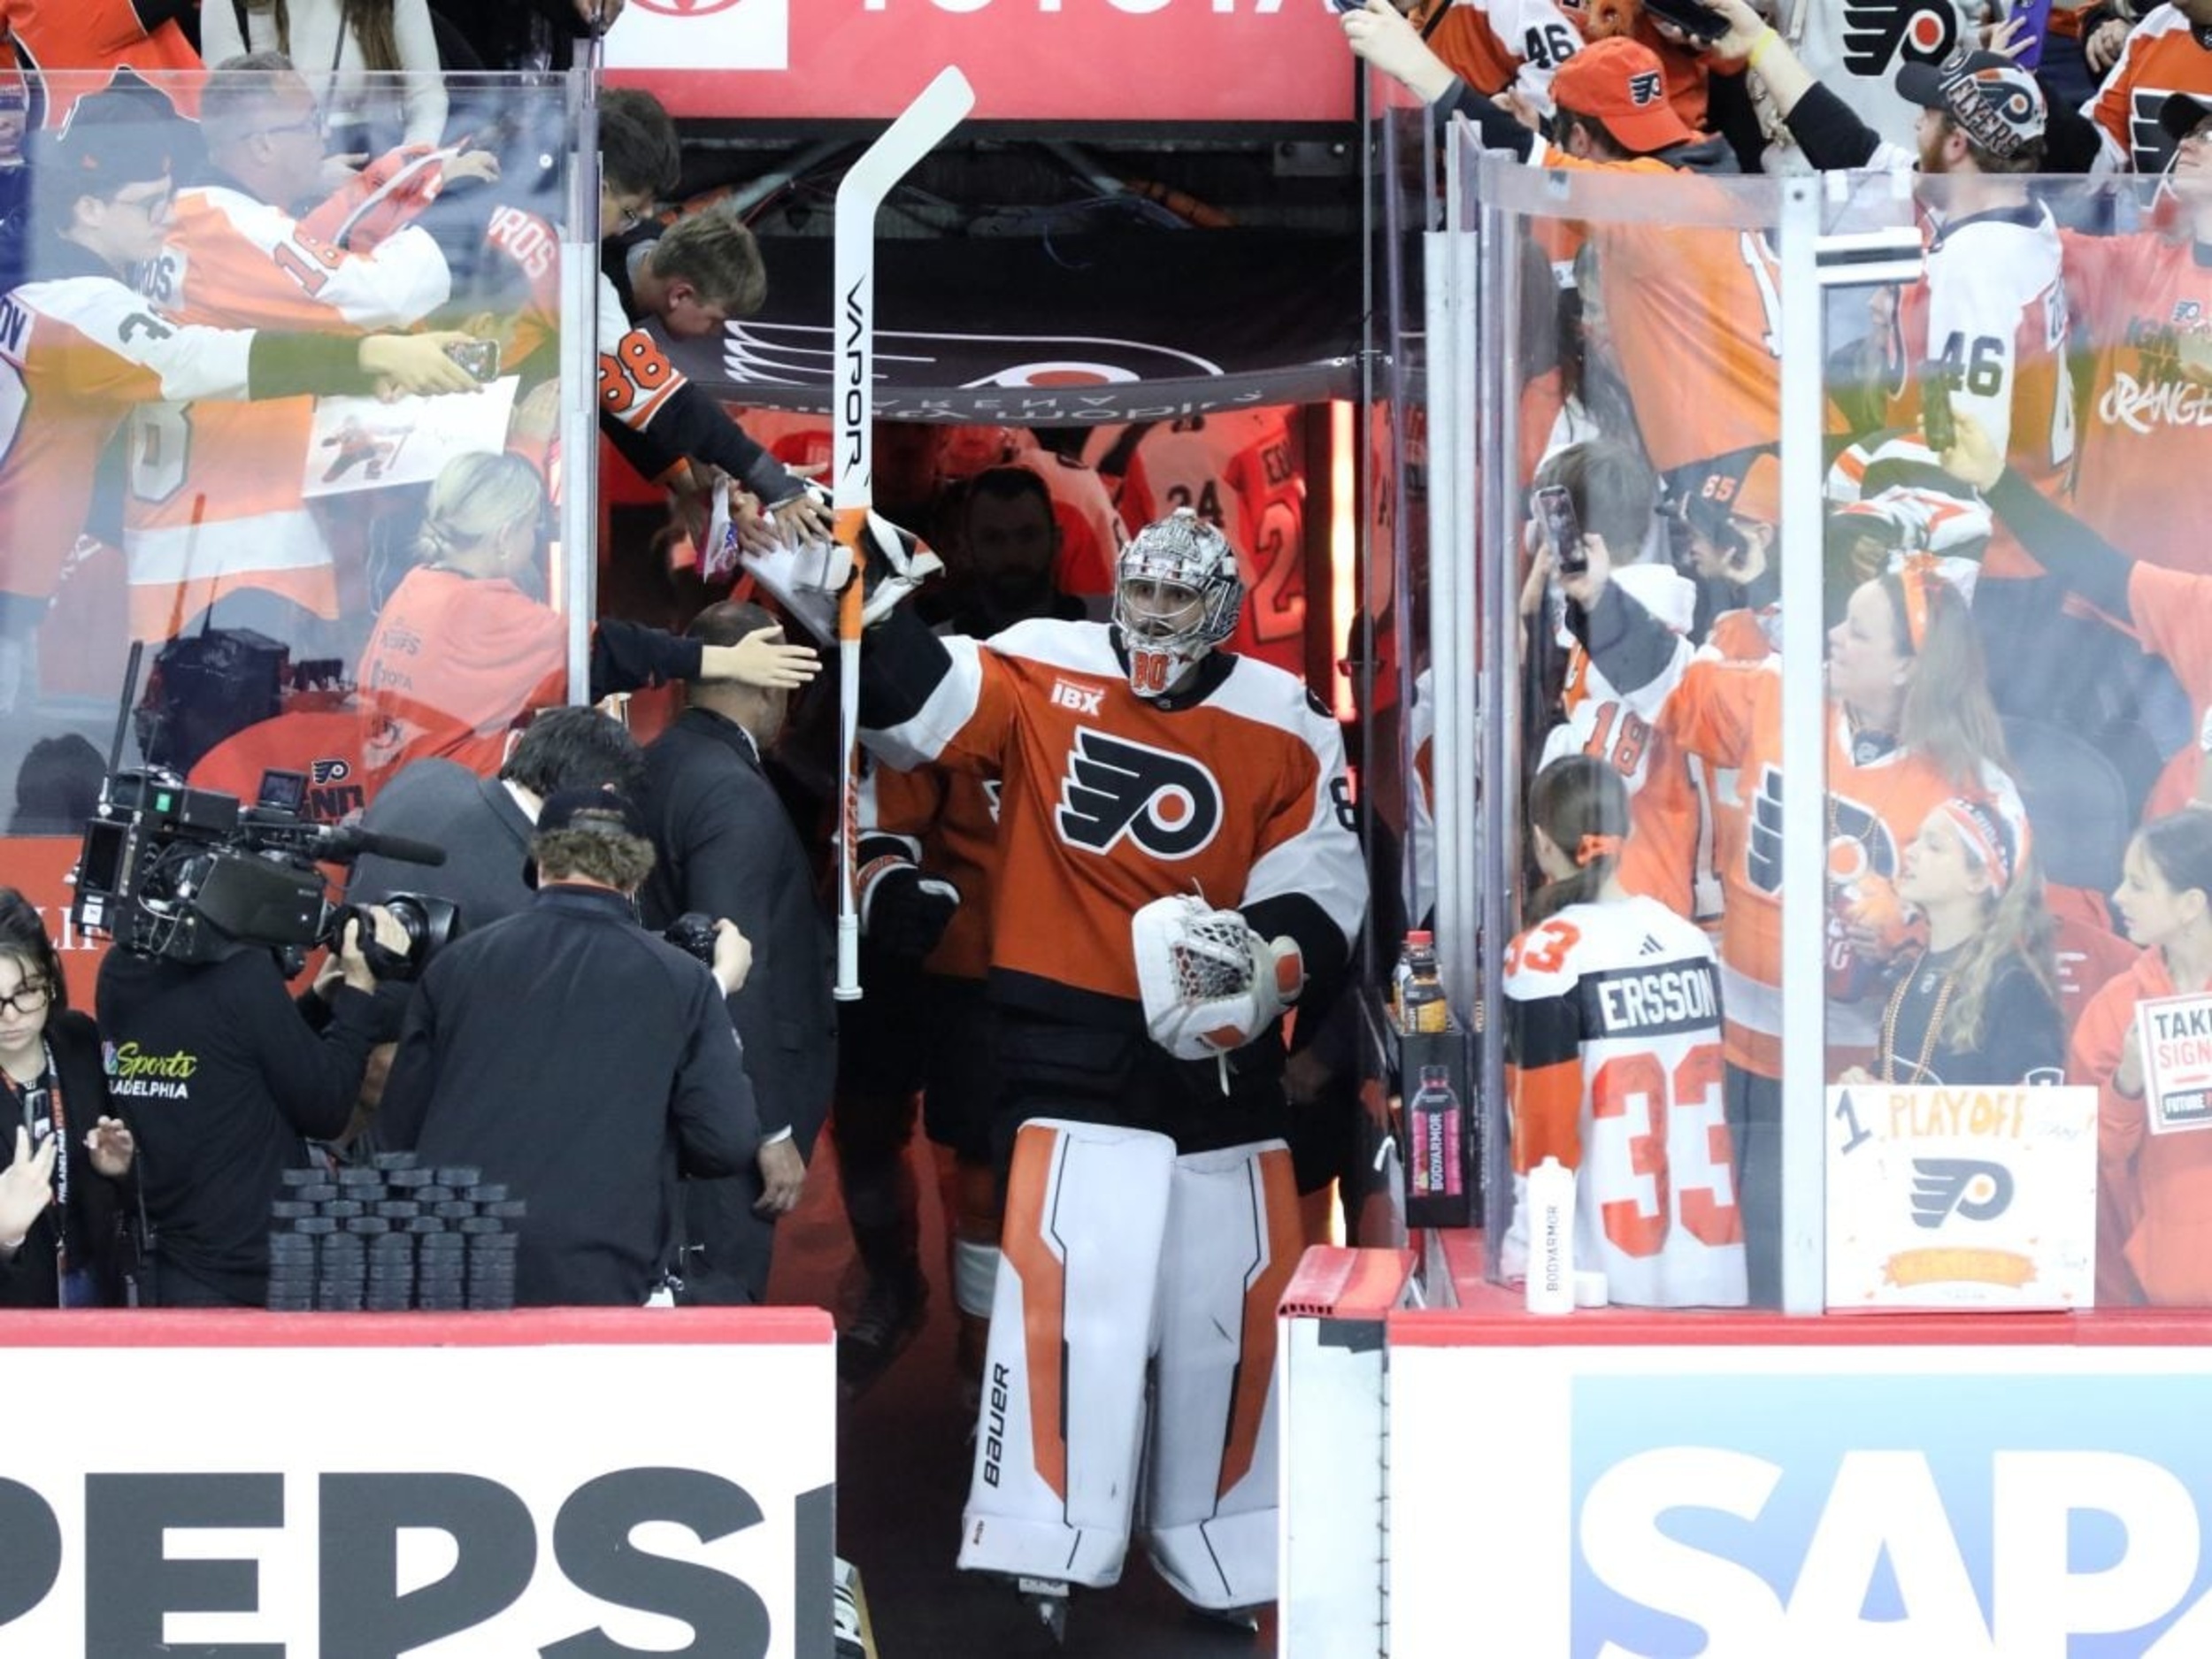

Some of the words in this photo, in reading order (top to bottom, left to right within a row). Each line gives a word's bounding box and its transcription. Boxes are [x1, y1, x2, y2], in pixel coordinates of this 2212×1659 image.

[1525, 24, 1576, 69] 46
[846, 273, 867, 480] VAPOR
[1940, 330, 2005, 397] 46
[1050, 679, 1105, 717] IBX
[1583, 701, 1650, 778] 18
[1598, 967, 1716, 1033] ERSSON
[2154, 1007, 2212, 1041] TAK
[117, 1041, 197, 1079] Sports
[1429, 1111, 1444, 1192] BODYARMOR
[1593, 1043, 1746, 1259] 33
[1546, 1204, 1559, 1293] BODYARMOR
[984, 1363, 1010, 1488] BAUER
[0, 1466, 836, 1659] EPS
[1579, 1446, 2200, 1659] SAP
